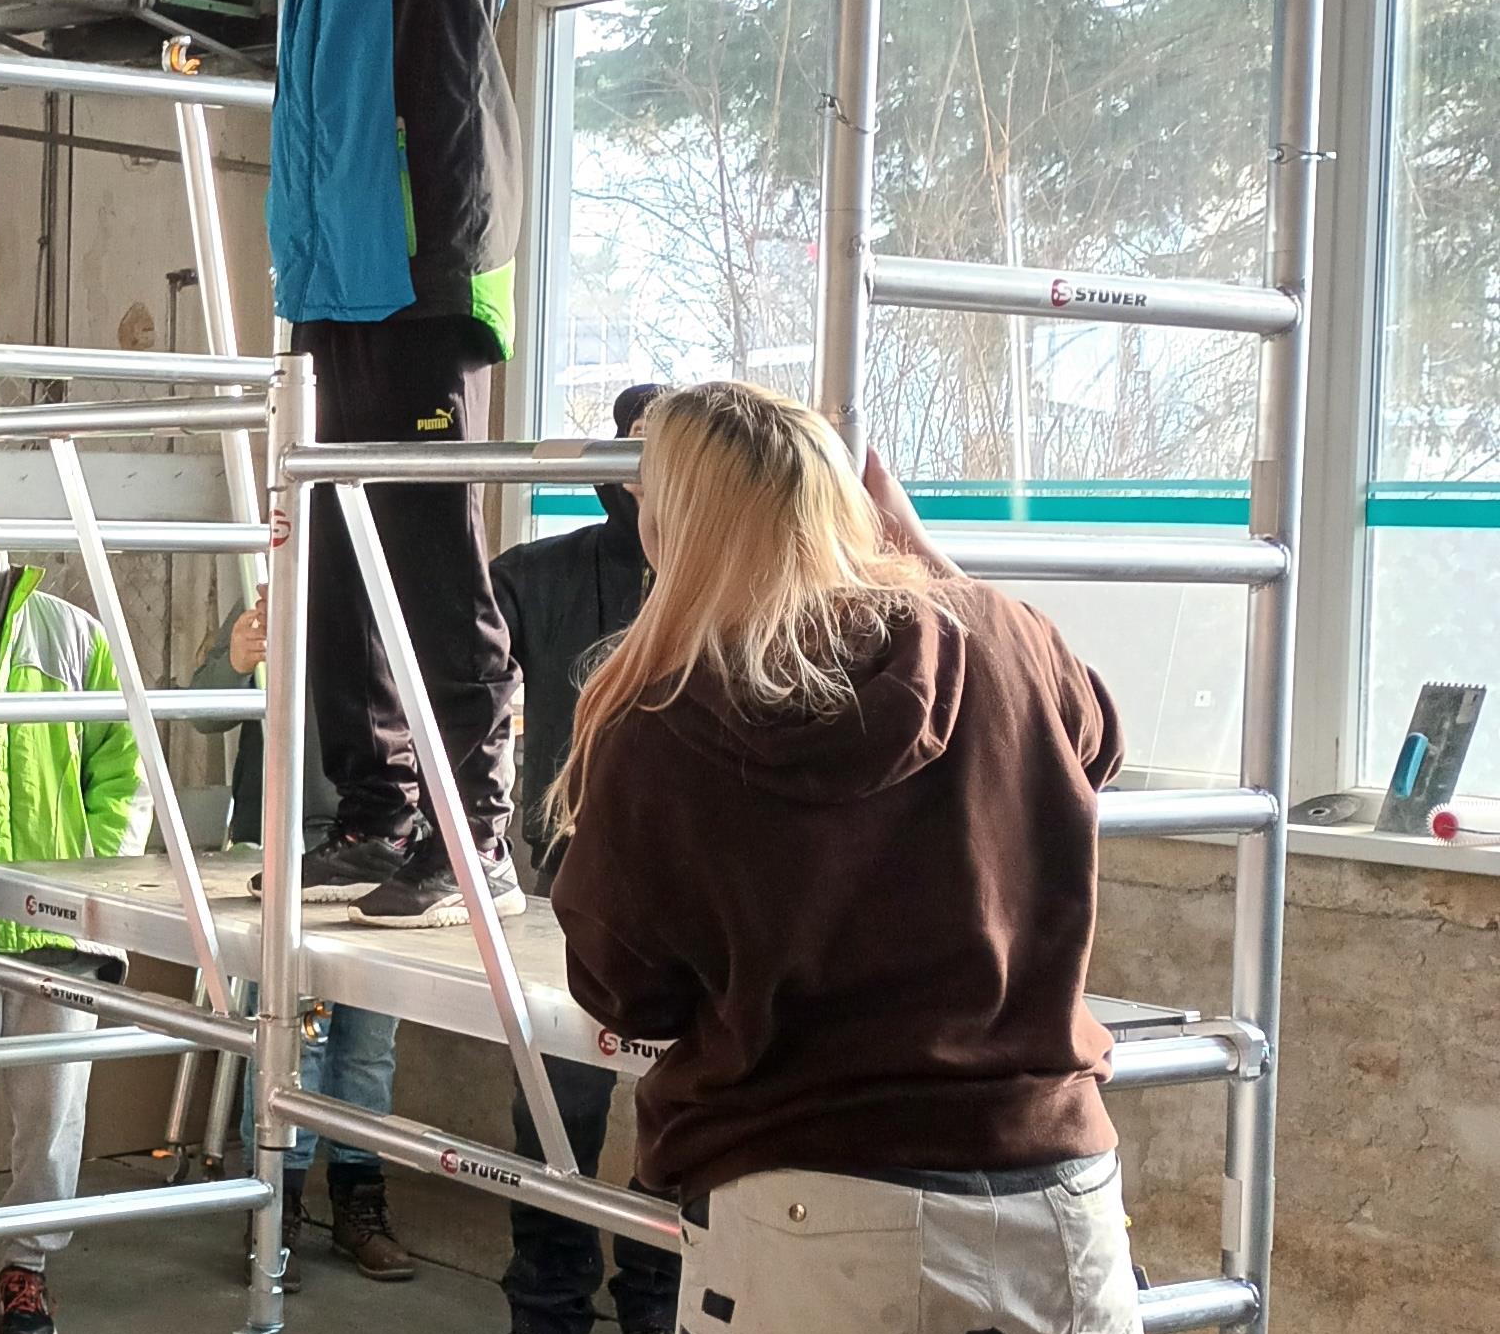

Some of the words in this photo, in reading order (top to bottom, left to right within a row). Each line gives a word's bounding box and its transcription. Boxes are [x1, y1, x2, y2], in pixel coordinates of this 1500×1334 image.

[1075, 286, 1148, 307] STUVER
[38, 902, 77, 921] STUVER
[52, 987, 94, 1007] STUVER
[460, 1159, 522, 1188] STUVER
